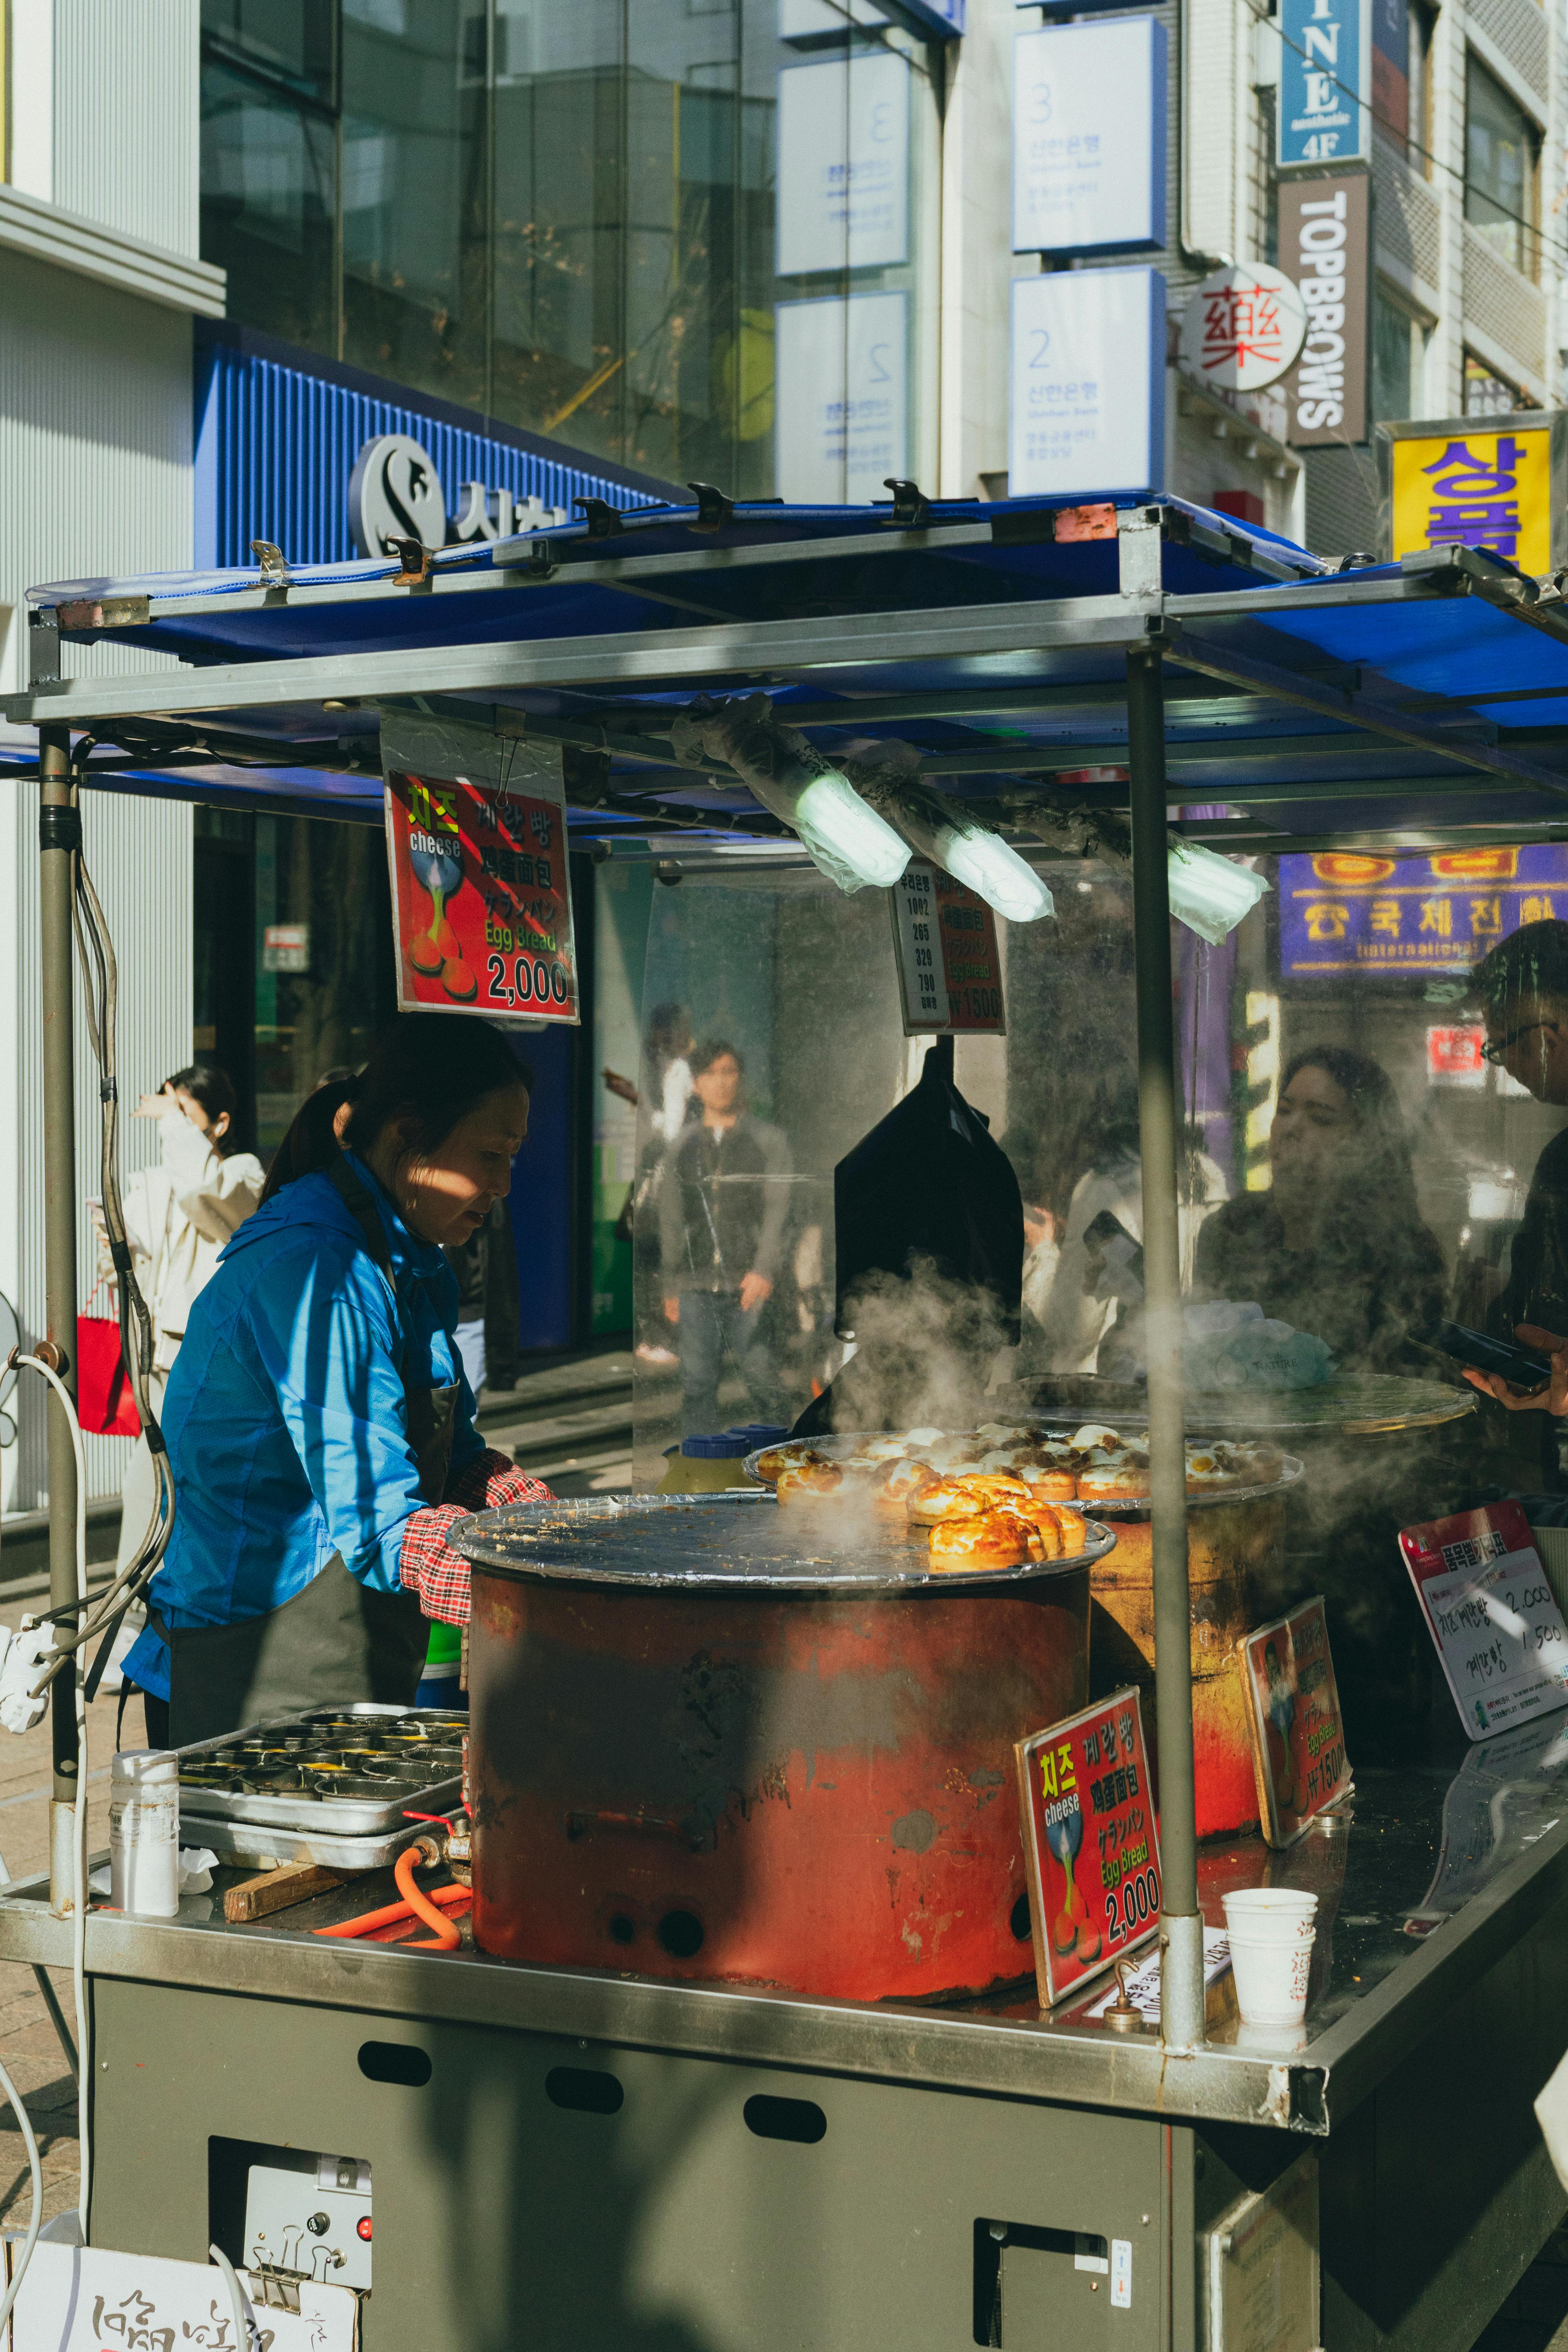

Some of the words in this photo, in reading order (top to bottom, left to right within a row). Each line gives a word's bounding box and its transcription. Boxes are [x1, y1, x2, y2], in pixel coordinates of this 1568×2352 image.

[1029, 83, 1053, 124] 3
[1302, 132, 1340, 159] 4F
[1202, 284, 1281, 370] 藥
[1297, 191, 1347, 430] TOPBROWS
[1029, 329, 1050, 368] 2
[1029, 382, 1098, 404] 신한은행
[1422, 437, 1526, 570] 상품
[407, 784, 459, 834] 치즈
[410, 831, 460, 858] cheese
[901, 874, 930, 892] 우리은행
[908, 897, 929, 916] 1002
[485, 920, 512, 951] Egg
[517, 925, 556, 951] Bread
[913, 924, 929, 941] 265
[916, 949, 932, 966] 329
[965, 962, 989, 978] Bread
[488, 954, 567, 1006] 2,000
[918, 974, 935, 991] 790
[1082, 1712, 1134, 1765] 계란빵
[1307, 1730, 1319, 1757] Egg
[1040, 1743, 1076, 1799] 치즈
[1045, 1792, 1079, 1828] cheese
[1101, 1860, 1120, 1889] Egg
[1121, 1833, 1148, 1872] Bread
[1105, 1866, 1159, 1943] 2,000
